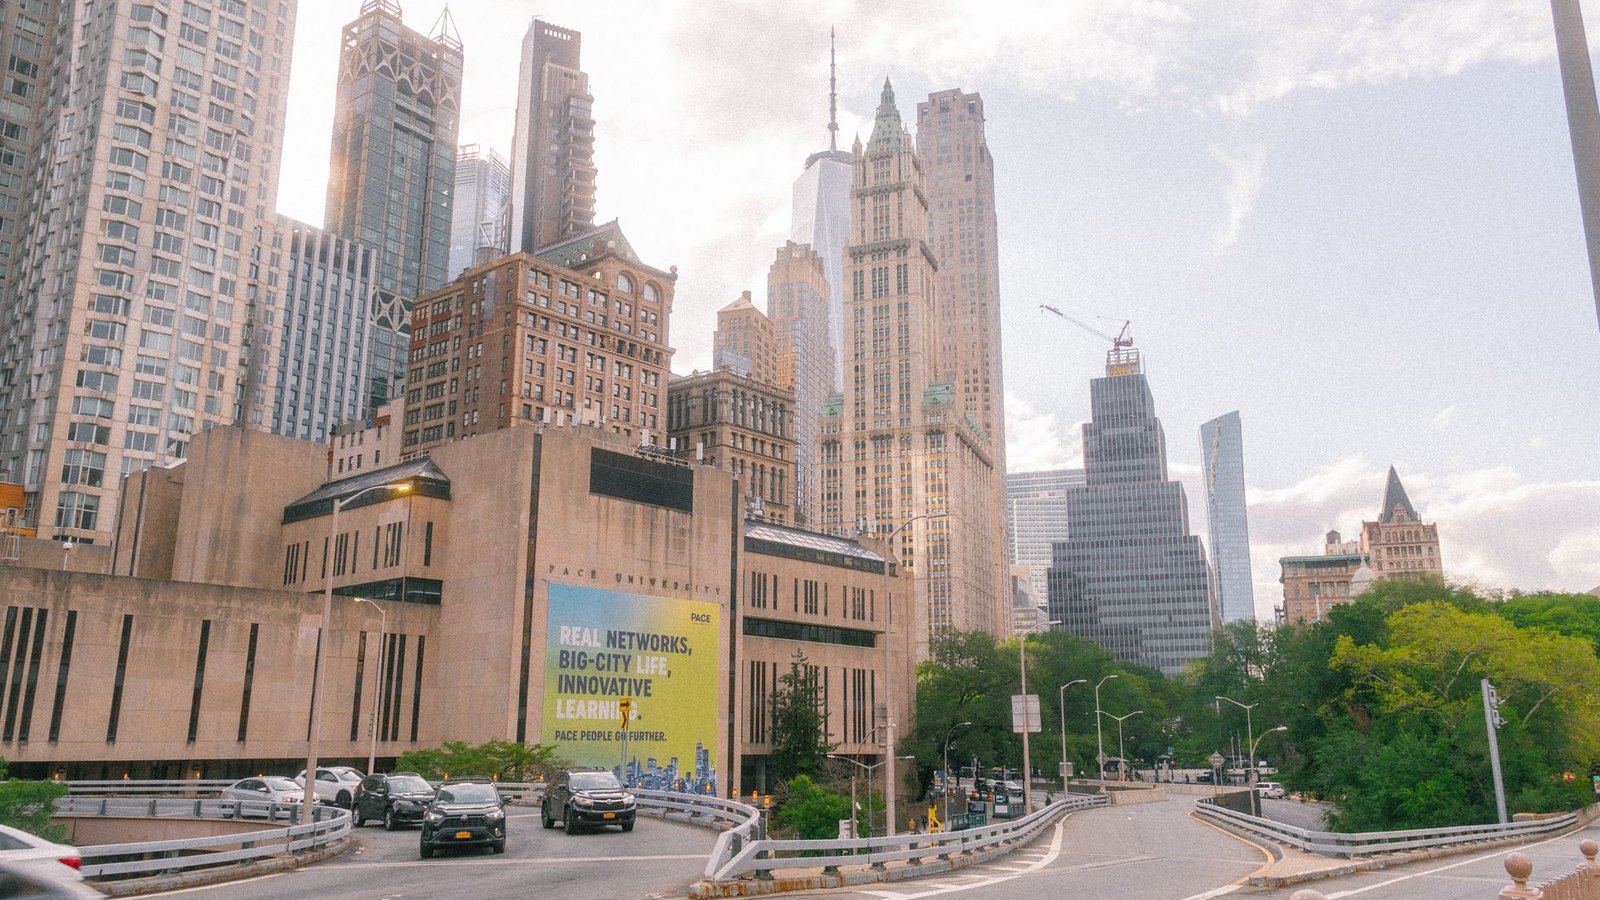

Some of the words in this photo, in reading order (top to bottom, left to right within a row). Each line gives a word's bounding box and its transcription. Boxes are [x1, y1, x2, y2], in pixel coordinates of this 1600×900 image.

[549, 565, 597, 579] PACE
[615, 573, 721, 596] UNIVERSITY
[691, 612, 711, 624] PACE
[560, 625, 600, 647] REAL
[606, 630, 692, 656] NETWORKS,
[559, 649, 632, 673] BIG-CITY
[636, 655, 671, 678] LIFE,
[557, 674, 652, 697] INNOVATIVE
[555, 730, 578, 741] PACE
[580, 731, 612, 741] PEOPLE
[629, 731, 667, 742] FURTHER.
